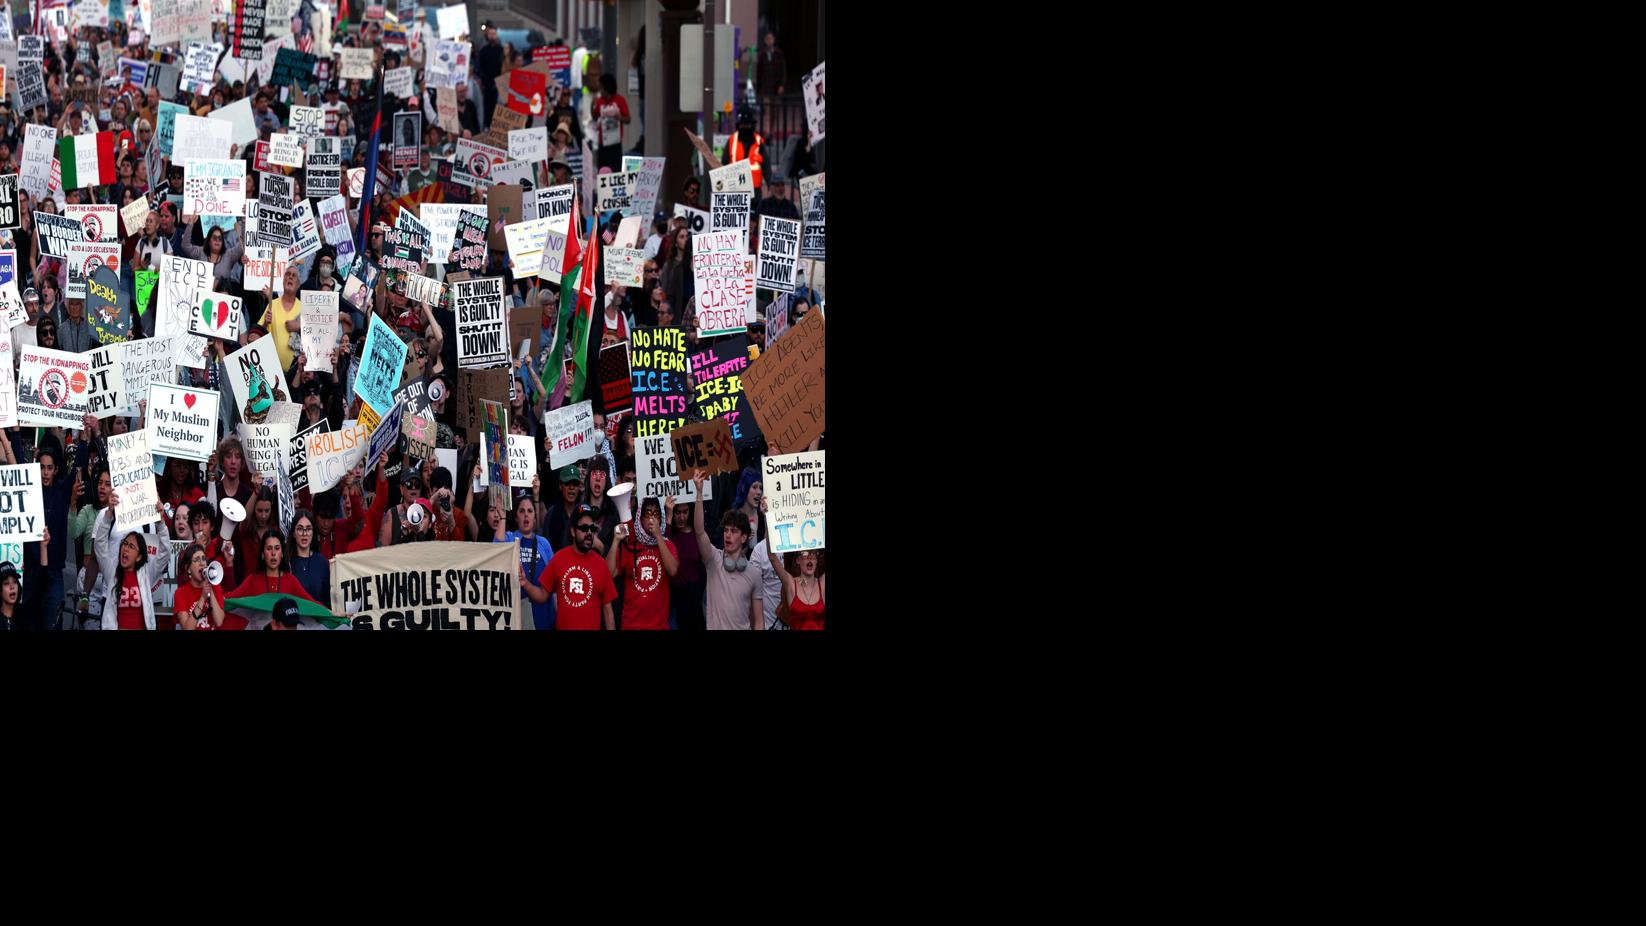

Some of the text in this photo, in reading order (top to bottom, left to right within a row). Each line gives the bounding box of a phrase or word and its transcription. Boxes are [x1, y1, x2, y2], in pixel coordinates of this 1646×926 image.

[244, 8, 264, 18] NEVER
[243, 18, 262, 26] MADE
[242, 28, 258, 36] ANY
[240, 50, 262, 60] GREAT
[294, 108, 323, 123] STOP
[28, 127, 54, 139] NO ONE
[296, 124, 318, 134] ICE
[36, 140, 41, 150] IS
[26, 152, 50, 164] ILLEGAL
[308, 154, 340, 165] JUSTICE FOR
[30, 166, 40, 175] ON
[21, 176, 48, 190] STOLEN
[206, 178, 217, 186] WE
[264, 178, 290, 196] TUCSON
[308, 178, 340, 188] NICOLE GOOD
[600, 178, 606, 187] I
[610, 174, 626, 186] LIKE
[612, 187, 626, 197] ICE
[714, 194, 748, 206] THE WHOLE
[194, 199, 232, 214] DONE.
[260, 193, 292, 210] MINNEAPOLIS
[260, 208, 292, 221] STOP
[460, 212, 489, 231] NO ONE
[714, 213, 747, 227] IS GUILTY
[39, 223, 82, 240] NO BORDER
[269, 221, 291, 238] TERROR
[764, 218, 797, 234] THE WHOLE
[384, 226, 401, 244] THIS
[410, 235, 422, 249] ALL
[436, 234, 448, 242] THE
[546, 235, 562, 251] NO
[698, 235, 737, 250] NO HAY
[762, 230, 797, 241] SYSTEM
[762, 237, 796, 256] IS GUILTY
[694, 254, 741, 266] FRONTERAS
[761, 253, 785, 264] SHUT
[172, 258, 206, 277] END
[720, 266, 745, 278] Lucha
[761, 262, 792, 283] DOWN!
[172, 271, 206, 289] ICE
[706, 278, 739, 290] De La
[89, 280, 116, 304] Death
[458, 280, 499, 298] THE WHOLE
[305, 294, 335, 306] LIBERTY
[458, 295, 501, 305] SYSTEM
[701, 289, 745, 309] CLASE
[306, 314, 333, 323] JUSTICE
[460, 302, 500, 323] IS GUILTY
[699, 308, 747, 330] OBRERA
[459, 323, 490, 334] SHUT
[124, 343, 142, 356] THE
[147, 338, 172, 354] MOST
[462, 332, 501, 356] DOWN!
[633, 328, 686, 352] NO HATE
[24, 354, 89, 371] STOP THE KIDNAPPINGS
[238, 349, 261, 373] NO
[371, 348, 395, 382] MELTS
[632, 350, 685, 372] NO FEAR
[694, 356, 747, 384] TOLERATE
[744, 361, 776, 392] ICE
[408, 382, 425, 397] OUT
[753, 392, 766, 411] BE
[768, 359, 800, 395] MORE
[170, 394, 174, 404] I
[408, 400, 418, 414] OF
[634, 396, 686, 416] MELTS
[762, 372, 818, 431] HITLER
[18, 406, 41, 416] PROTECT
[42, 408, 54, 418] YOUR
[154, 408, 210, 427] My Muslim
[157, 426, 204, 443] Neighbor
[255, 427, 270, 437] NO
[108, 432, 146, 455] MONEY 4
[247, 438, 280, 448] HUMAN
[290, 436, 304, 455] NO
[308, 424, 366, 457] ABOLISH
[644, 438, 665, 455] WE
[110, 452, 151, 472] JOBS AND
[248, 449, 271, 460] BEING
[766, 456, 821, 474] Somewhere in
[113, 466, 155, 487] EDUCATION
[776, 471, 824, 491] a LITTLE
[131, 493, 148, 504] WAR
[772, 499, 780, 509] is
[782, 491, 811, 507] HIDING
[775, 509, 824, 523] Writing About
[341, 569, 512, 612] THE WHOLE SYSTEM
[570, 578, 584, 594] PSL
[119, 586, 142, 608] 23
